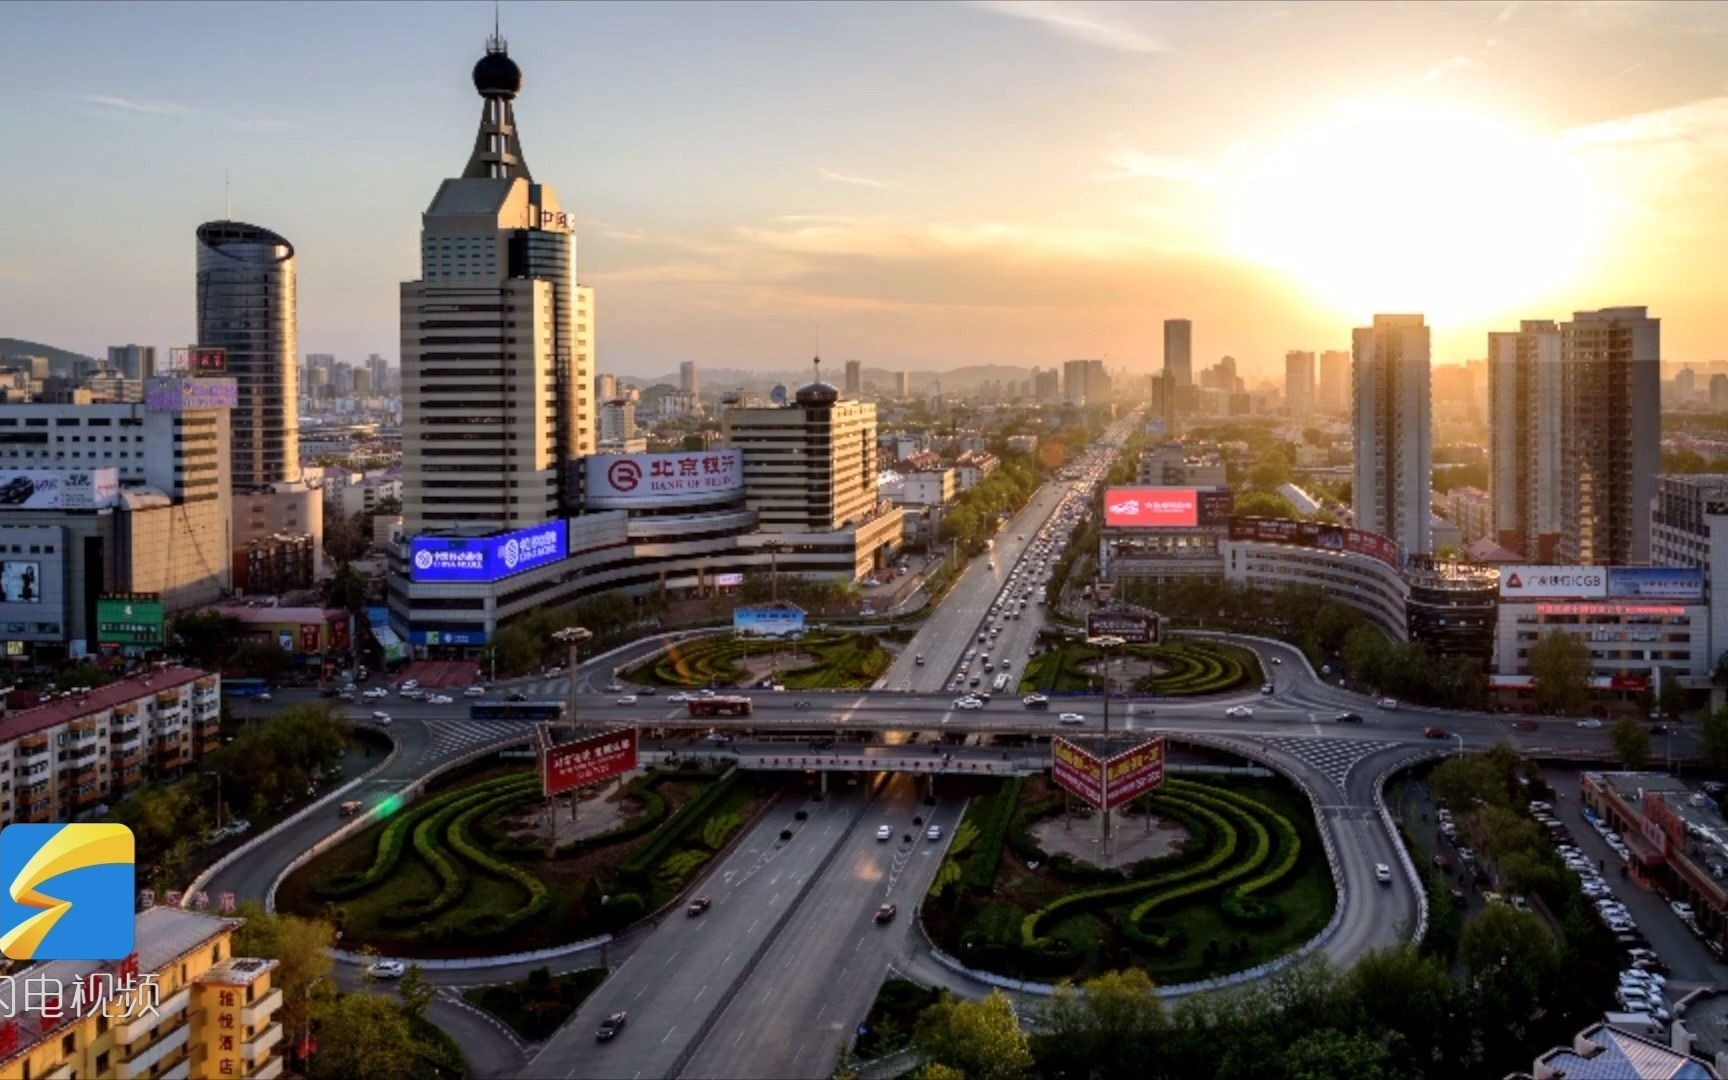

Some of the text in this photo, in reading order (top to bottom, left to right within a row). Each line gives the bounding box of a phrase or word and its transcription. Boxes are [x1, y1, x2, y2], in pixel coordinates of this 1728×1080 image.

[651, 456, 735, 477] 北京银行
[651, 480, 683, 490] BANK
[1575, 575, 1600, 587] CGB
[217, 989, 235, 1076] 雅悦酒店
